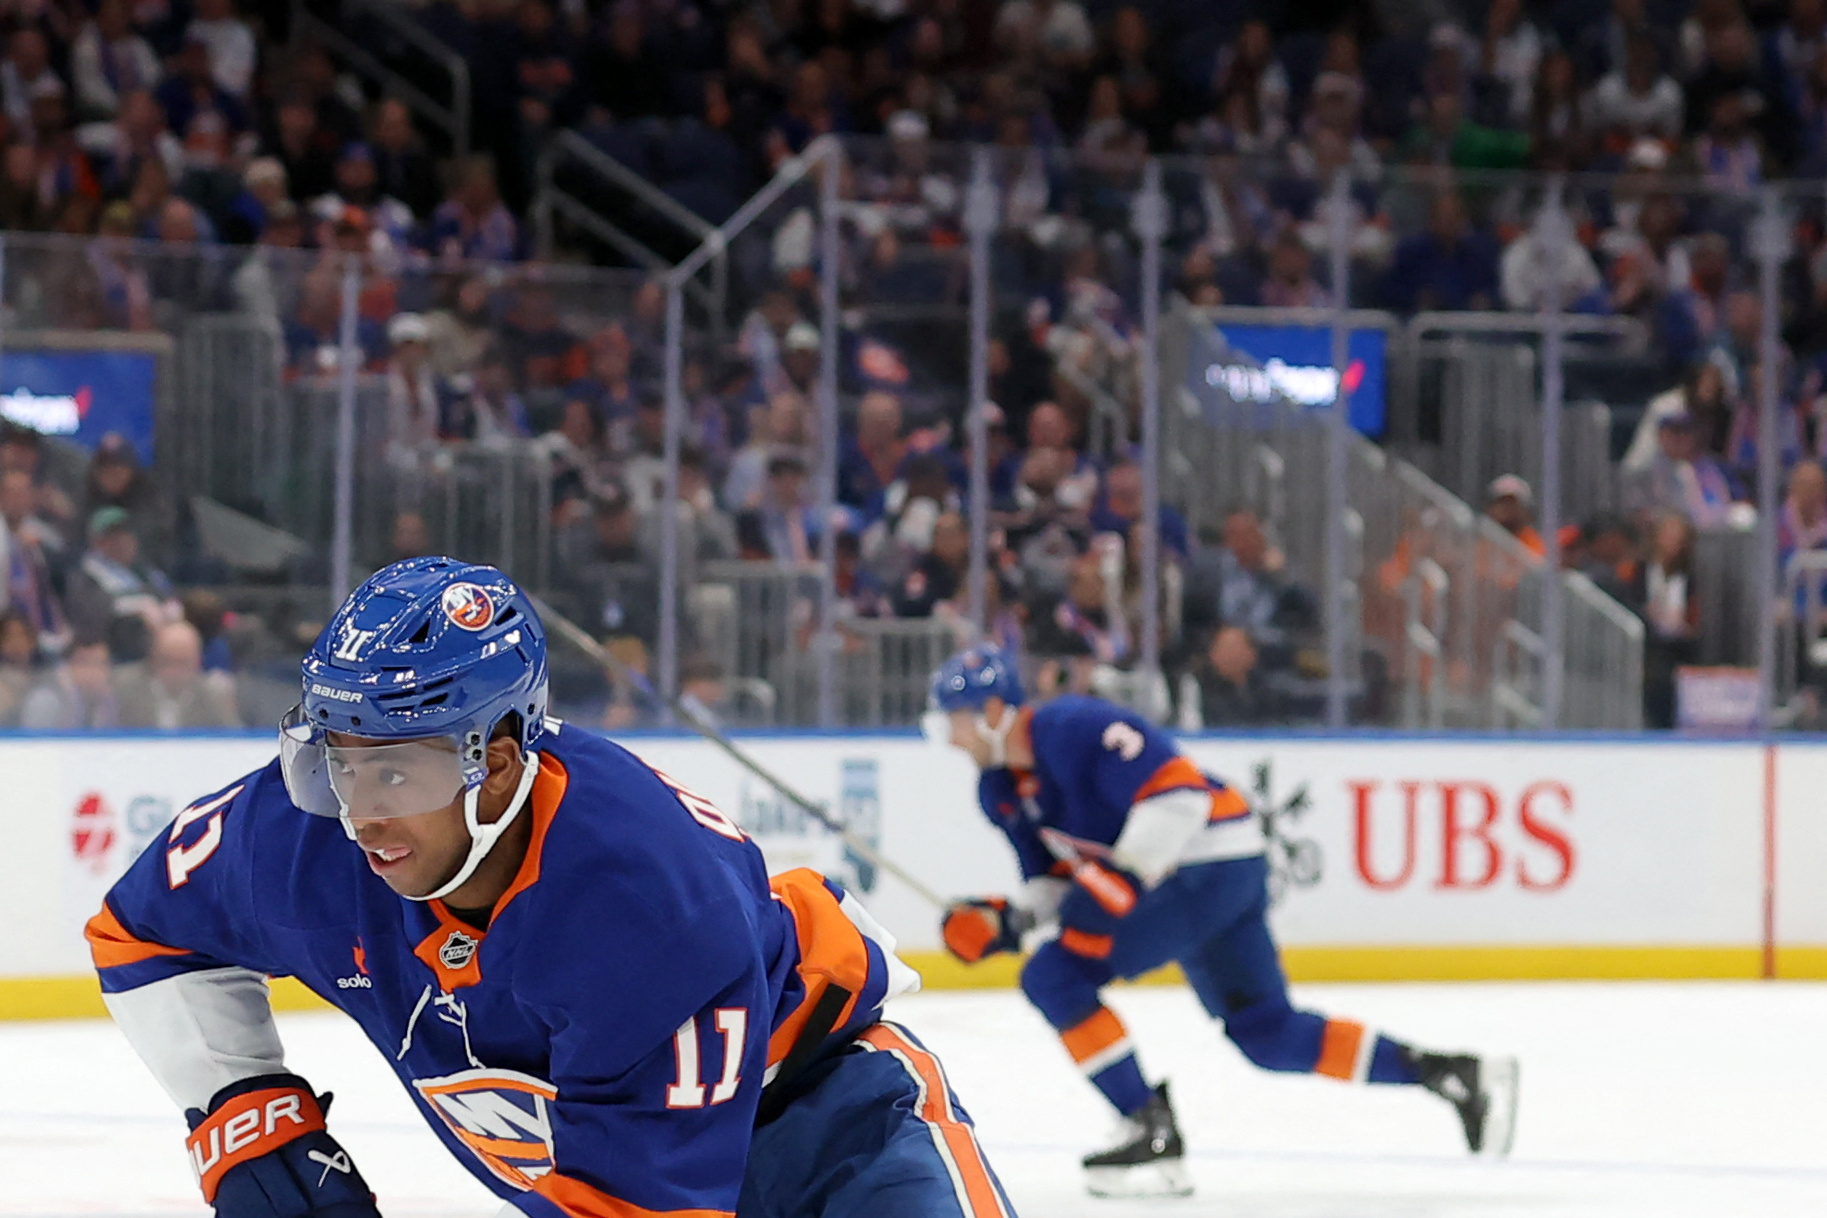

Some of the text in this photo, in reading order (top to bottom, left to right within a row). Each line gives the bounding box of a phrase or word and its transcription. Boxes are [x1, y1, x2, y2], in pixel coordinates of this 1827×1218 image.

[311, 683, 364, 704] BAUER
[1102, 721, 1145, 761] 3
[166, 784, 246, 890] 11
[1344, 778, 1577, 892] UBS
[336, 973, 372, 989] solo
[665, 1006, 749, 1110] 11
[190, 1094, 305, 1180] UER
